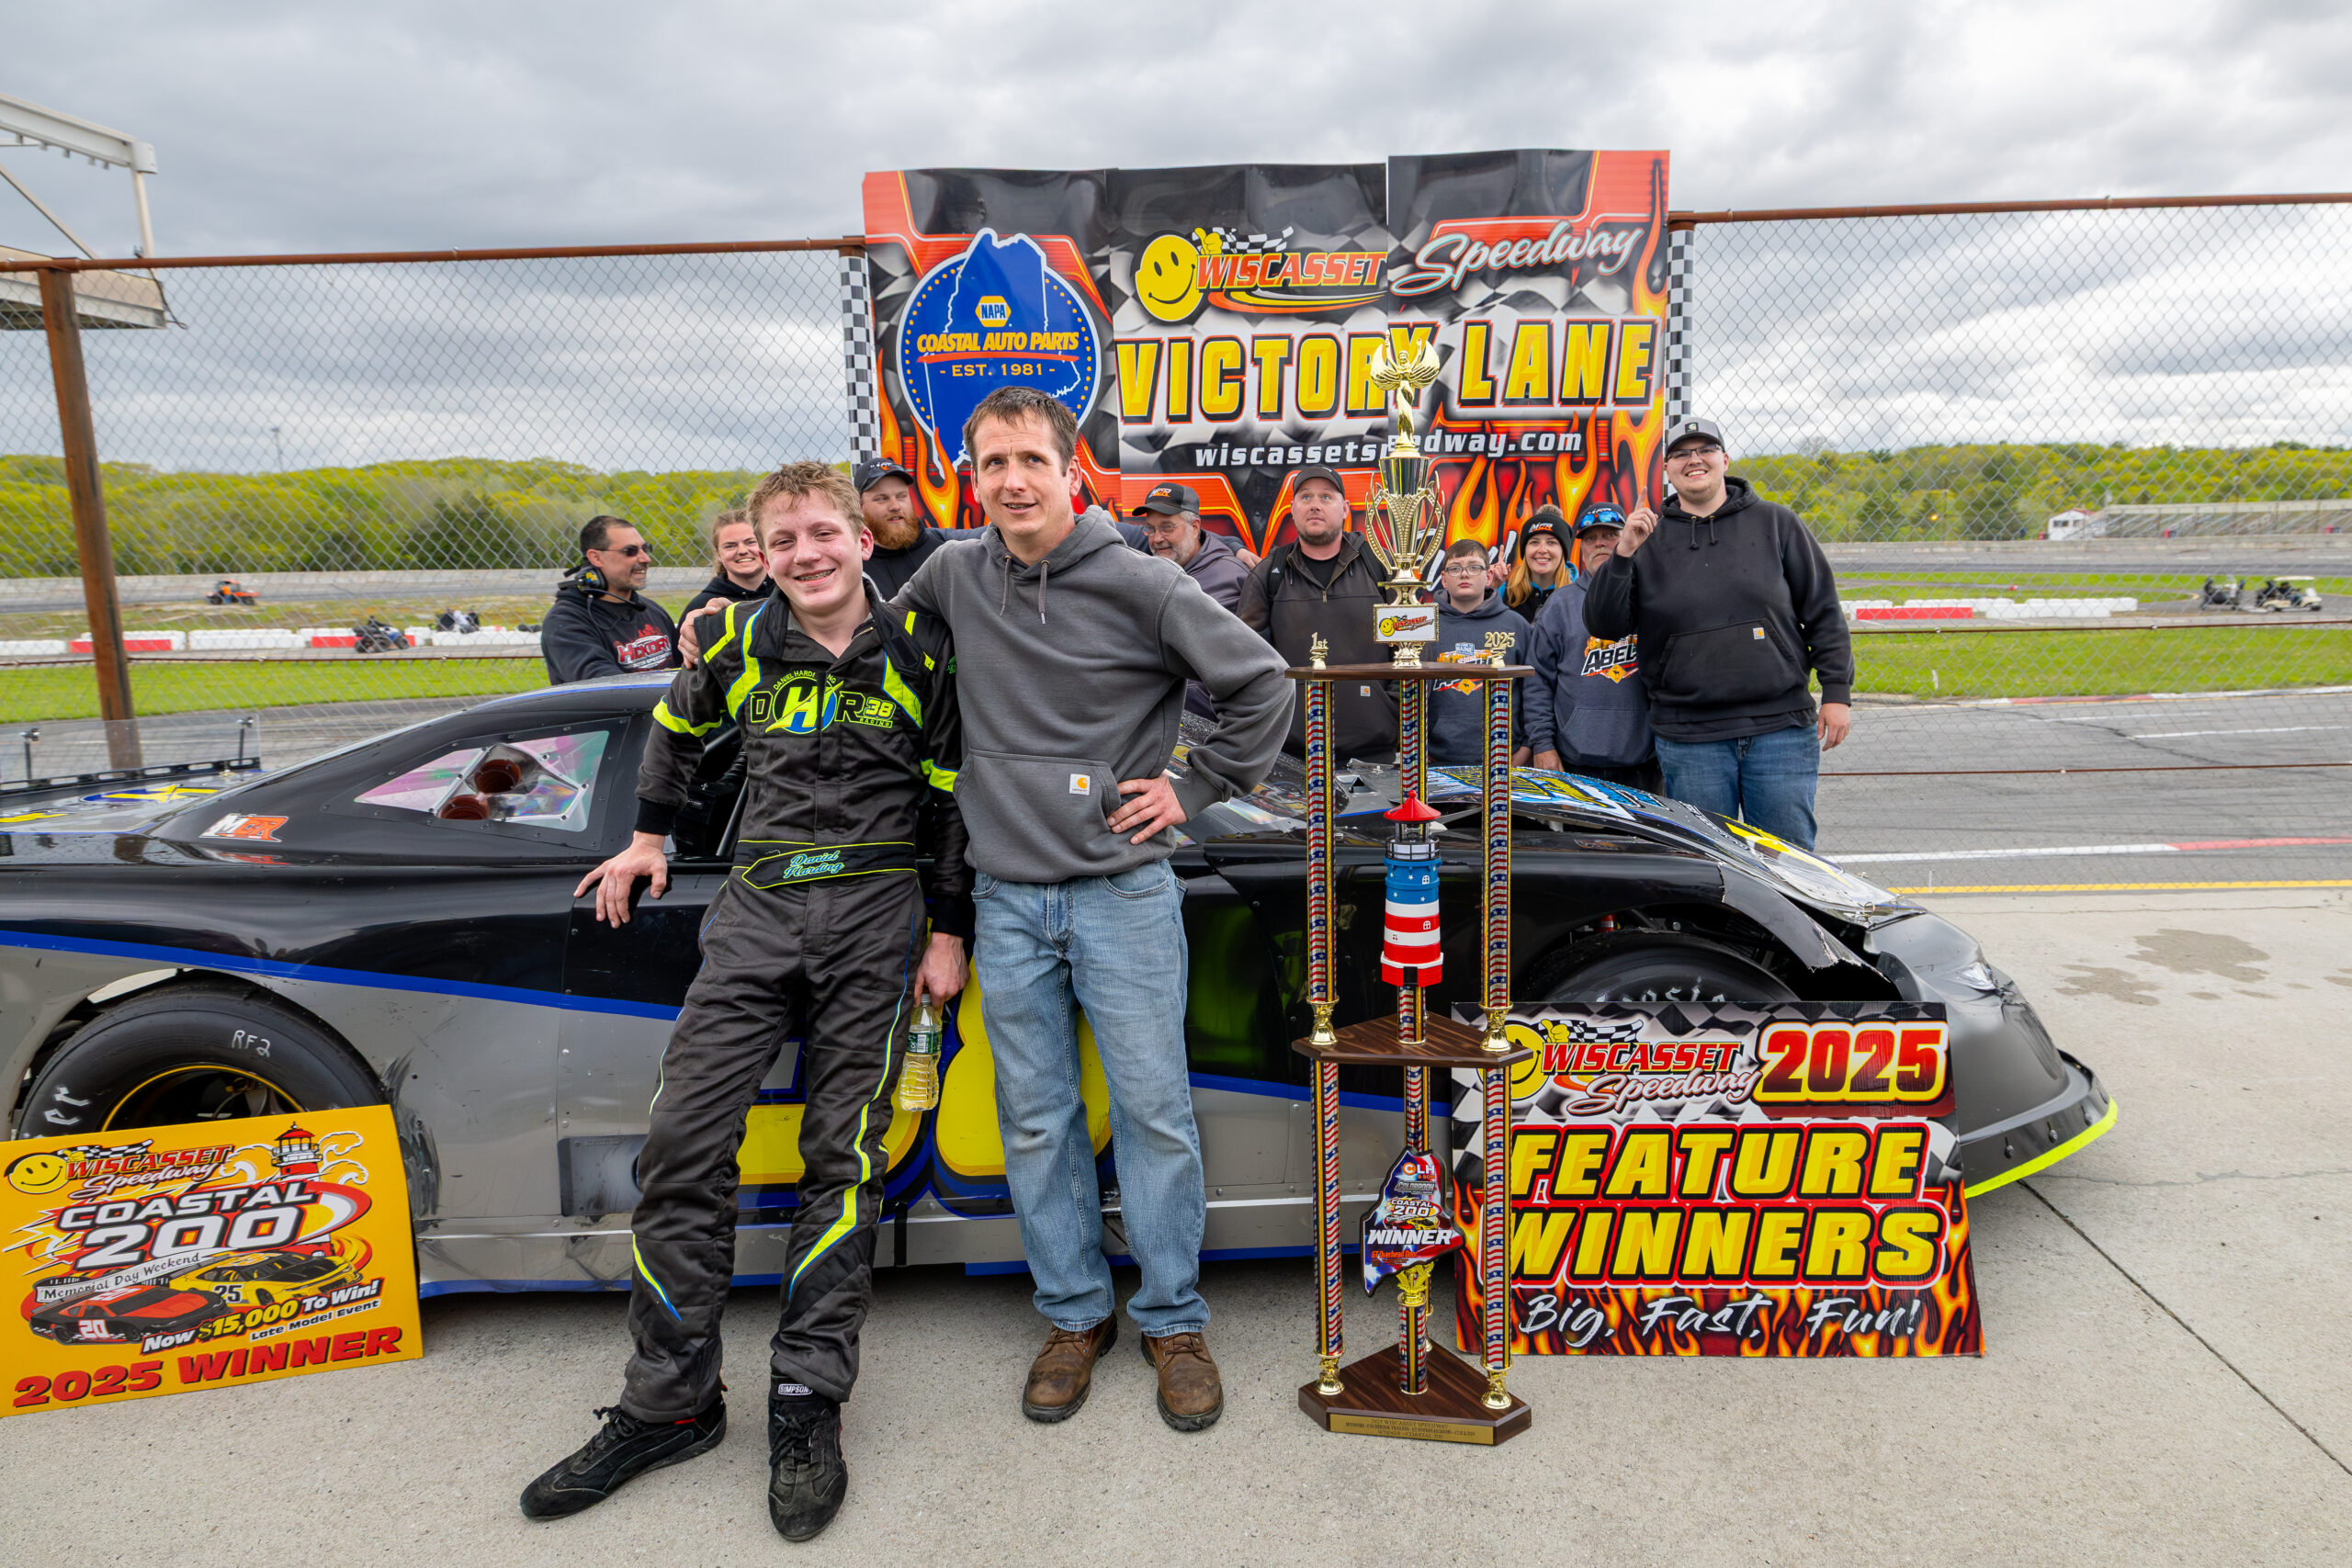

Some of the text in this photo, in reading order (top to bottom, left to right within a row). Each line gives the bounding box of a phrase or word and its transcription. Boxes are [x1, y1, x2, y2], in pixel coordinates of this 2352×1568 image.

[1196, 223, 1645, 297] WISCASSET Speedway
[979, 303, 1008, 320] NAPA
[917, 332, 1080, 353] COASTAL AUTO PARTS
[952, 364, 1043, 377] EST. 1981
[1461, 319, 1655, 408] LANE
[1484, 631, 1516, 648] 2025
[773, 673, 794, 690] DANIEL
[864, 696, 896, 720] 38
[783, 862, 845, 879] Harding
[790, 850, 841, 867] Daniel
[231, 1029, 271, 1057] RF2
[1541, 1025, 1948, 1100] WISCASSET 2025
[1566, 1071, 1762, 1116] Speedway
[65, 1145, 235, 1179] WISCASSET
[1511, 1125, 1928, 1201] FEATURE
[68, 1162, 219, 1200] Speedway
[59, 1183, 317, 1230] COASTAL
[1391, 1199, 1432, 1208] COASTAL
[1394, 1205, 1430, 1217] 200
[74, 1209, 300, 1269] 200
[1367, 1229, 1453, 1245] WINNER
[1511, 1205, 1945, 1281] WINNERS
[43, 1252, 200, 1300] Memorial Day Weekend
[213, 1284, 243, 1303] 25
[79, 1319, 110, 1339] 20
[141, 1280, 382, 1354] Now $15,000 To Win!
[251, 1300, 380, 1341] Late Model Event
[1519, 1294, 1919, 1348] Big, Fast, Fun!
[13, 1325, 402, 1408] 2025 WINNER
[780, 1384, 809, 1394] SIMPSON
